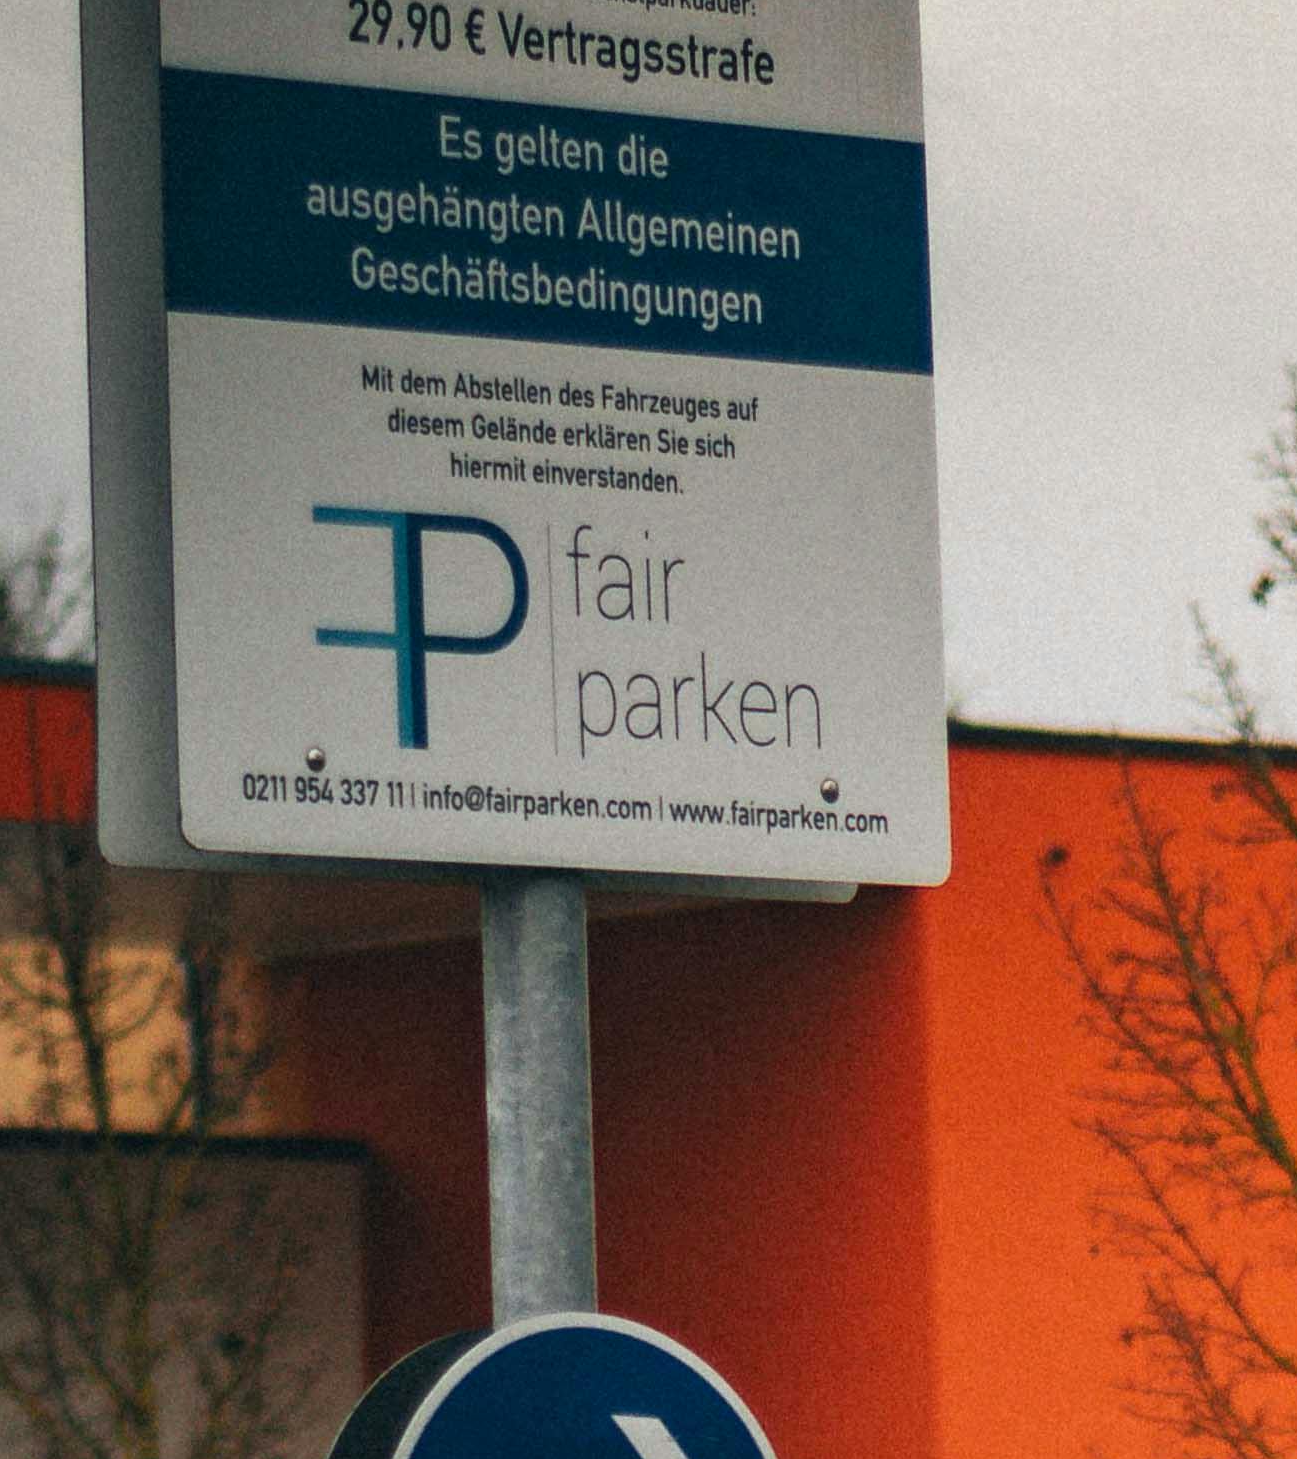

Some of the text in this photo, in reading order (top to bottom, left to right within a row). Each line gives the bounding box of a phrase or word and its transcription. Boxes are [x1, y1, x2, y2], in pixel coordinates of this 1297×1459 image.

[464, 7, 486, 56] €
[498, 11, 775, 86] Vertragsstrafe
[440, 115, 669, 179] Es gelten die
[307, 182, 800, 260] ausgehängten Allgemeinen
[352, 246, 763, 331] Geschäftsbedingungen
[362, 365, 759, 423] Mit dem Abstellen des Fahrzeuges auf
[388, 408, 736, 460] diesem Gelände erklären Sie sich
[451, 452, 684, 495] hiermit einverstanden.
[566, 524, 684, 622] fair
[578, 650, 821, 760] parken
[242, 773, 287, 802] 0211
[295, 775, 334, 805] 954
[340, 779, 379, 807] 337
[423, 782, 652, 821] info@fairparken.com
[669, 800, 888, 834] www.fairparken.com
